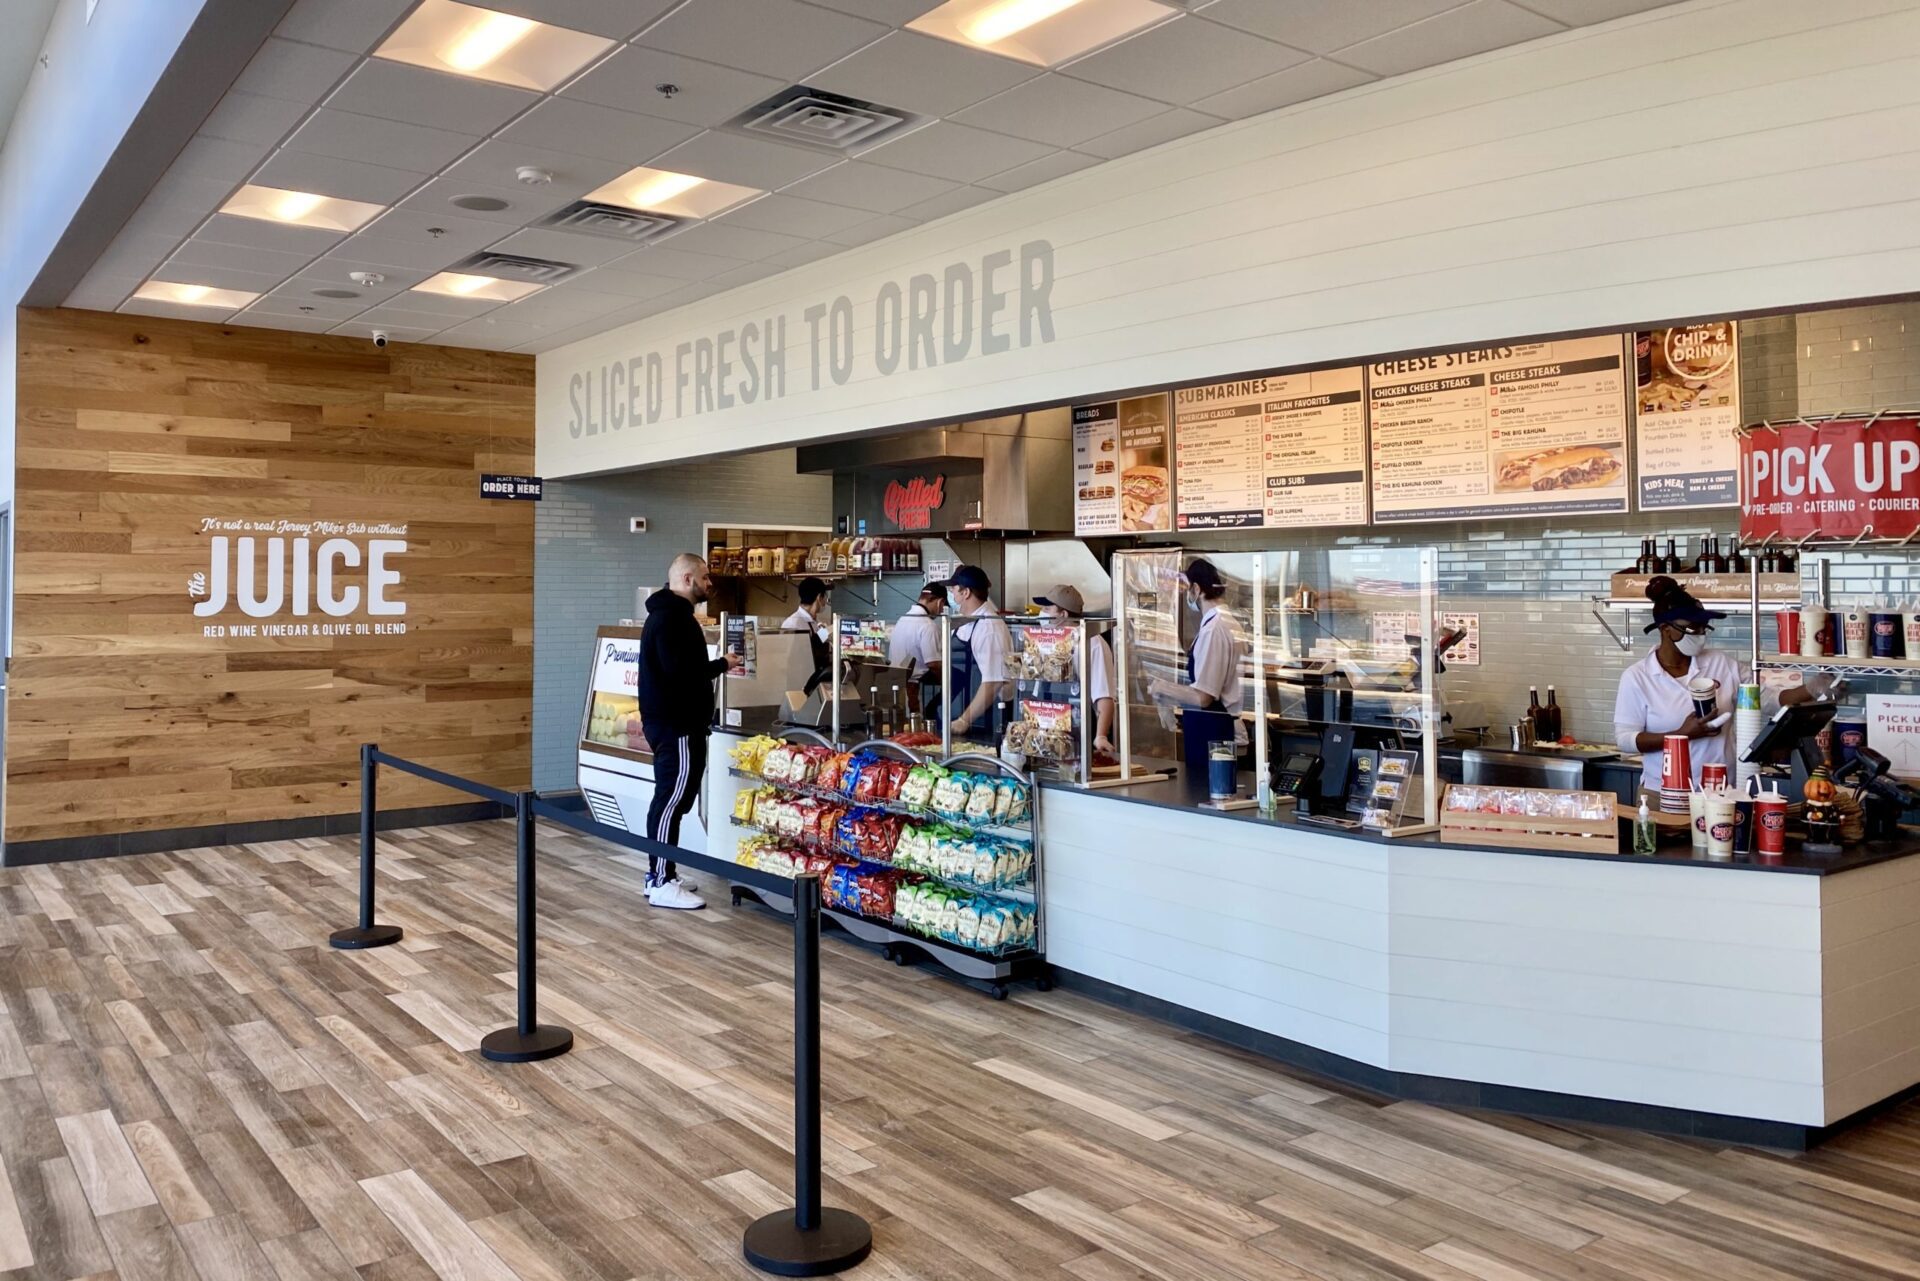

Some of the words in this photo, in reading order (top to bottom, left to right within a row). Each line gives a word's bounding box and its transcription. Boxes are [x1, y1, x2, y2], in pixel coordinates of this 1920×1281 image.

[568, 351, 662, 440] SLICED
[676, 315, 786, 418] FRESH
[804, 295, 854, 391] TO
[875, 239, 1056, 377] ORDER
[1674, 331, 1709, 347] CHIP
[1716, 328, 1726, 341] &
[1374, 356, 1437, 376] CHEESE
[1446, 344, 1513, 366] STEAKS
[1673, 343, 1728, 362] DRINK!
[1494, 370, 1526, 382] CHEESE
[1529, 365, 1561, 378] STEAKS
[1178, 379, 1268, 404] SUBMARINES
[1375, 385, 1407, 398] CHICKEN
[1409, 381, 1439, 393] CHEESE
[1441, 377, 1470, 390] STEAKS
[1268, 401, 1293, 411] ITALIAN
[1295, 396, 1330, 408] FAVORITES
[1076, 408, 1100, 420] BREADS
[1179, 412, 1209, 422] AMERICAN
[1210, 408, 1236, 419] CLASSICS
[1752, 443, 1836, 498] PICK
[1854, 441, 1920, 493] UP
[482, 482, 514, 493] ORDER
[517, 484, 541, 494] HERE
[1269, 478, 1287, 486] CLUB
[1288, 476, 1305, 485] SUBS
[1644, 480, 1663, 491] KIDS
[1664, 478, 1685, 488] MEAL
[884, 474, 944, 524] Grilled
[1752, 502, 1793, 516] PRE-ORDER
[1804, 499, 1856, 513] CATERING
[1869, 498, 1920, 511] COURIER
[201, 518, 221, 532] It's
[223, 518, 242, 530] not
[244, 522, 251, 530] a
[252, 520, 275, 532] real
[277, 520, 311, 537] Jersey
[313, 521, 344, 534] Mike's
[346, 522, 366, 536] Sub
[367, 523, 407, 535] without
[898, 506, 931, 531] FRESH
[188, 571, 206, 598] the
[193, 536, 408, 617] JUICE
[203, 625, 225, 637] RED
[229, 625, 257, 637] WINE
[262, 624, 308, 636] VINEGAR
[312, 624, 320, 636] &
[322, 624, 351, 635] OLIVE
[355, 623, 371, 635] OIL
[374, 623, 407, 635] BLEND
[1878, 714, 1908, 723] PICK
[1887, 725, 1920, 734] HERE
